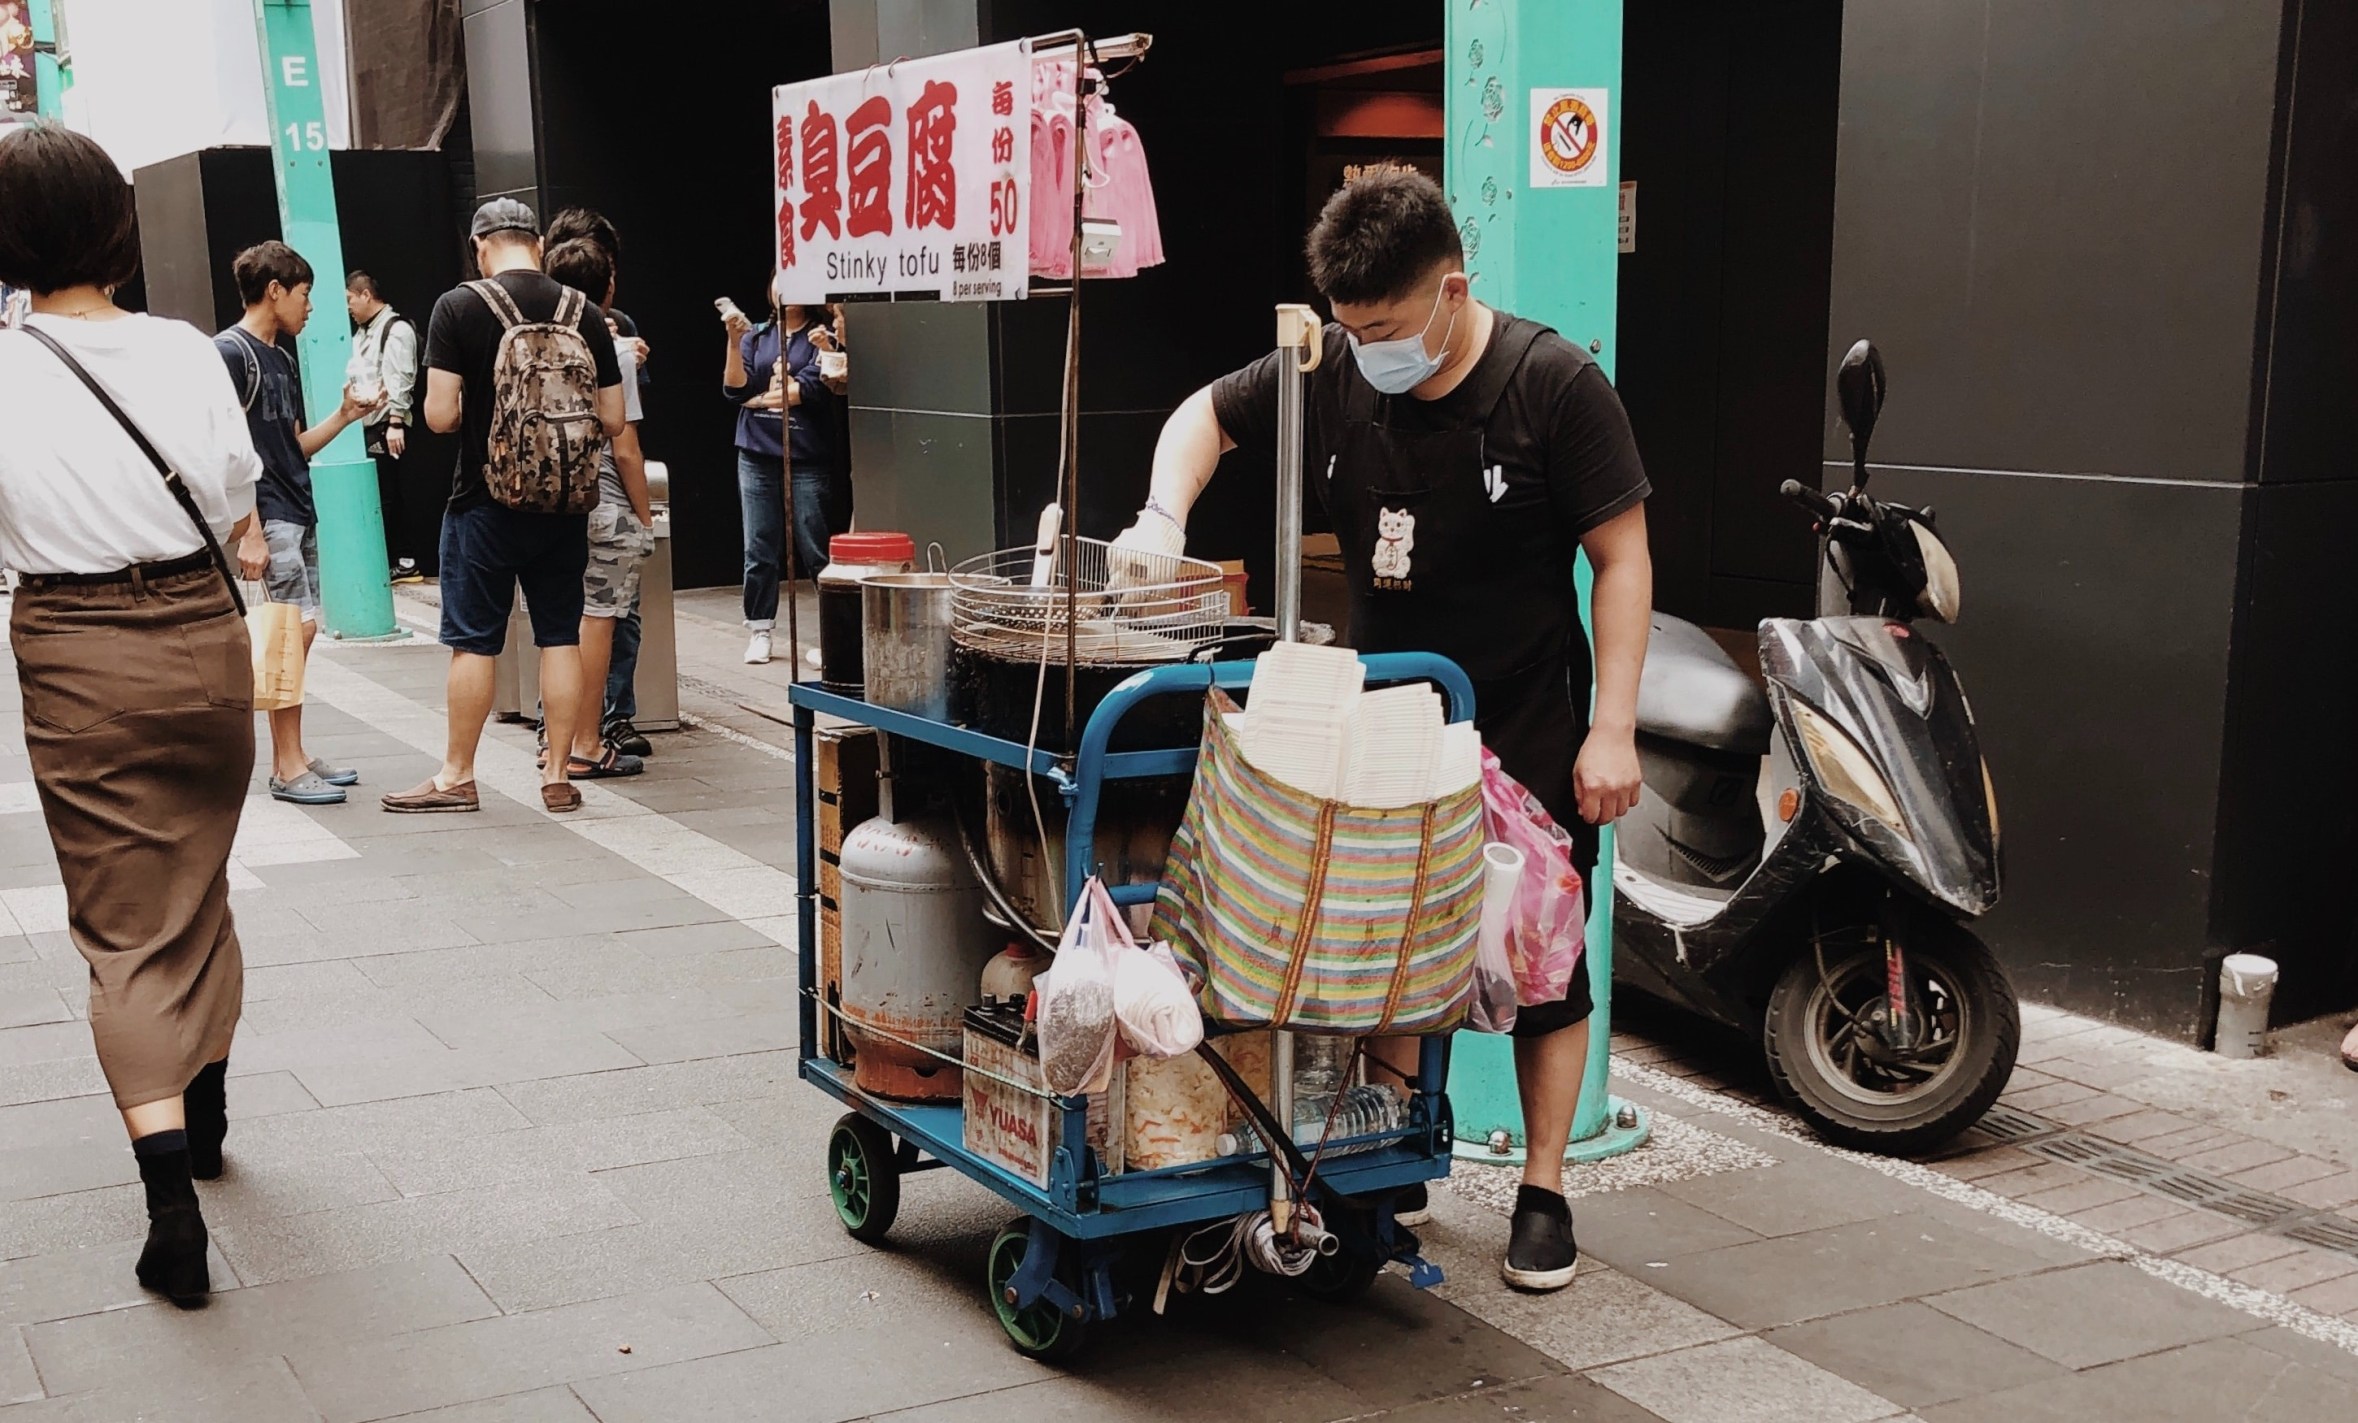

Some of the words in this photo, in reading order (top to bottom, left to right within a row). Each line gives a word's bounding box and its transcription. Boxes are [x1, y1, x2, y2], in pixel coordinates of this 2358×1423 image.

[282, 56, 309, 87] E
[285, 121, 325, 152] 15
[799, 80, 958, 242] 臭豆腐
[990, 178, 1017, 237] 50
[826, 250, 887, 286] Stinky
[899, 245, 940, 278] tofu
[952, 240, 1002, 273] 每份8個
[959, 282, 972, 299] per
[973, 278, 1002, 298] serving
[989, 1103, 1038, 1147] YUASA
